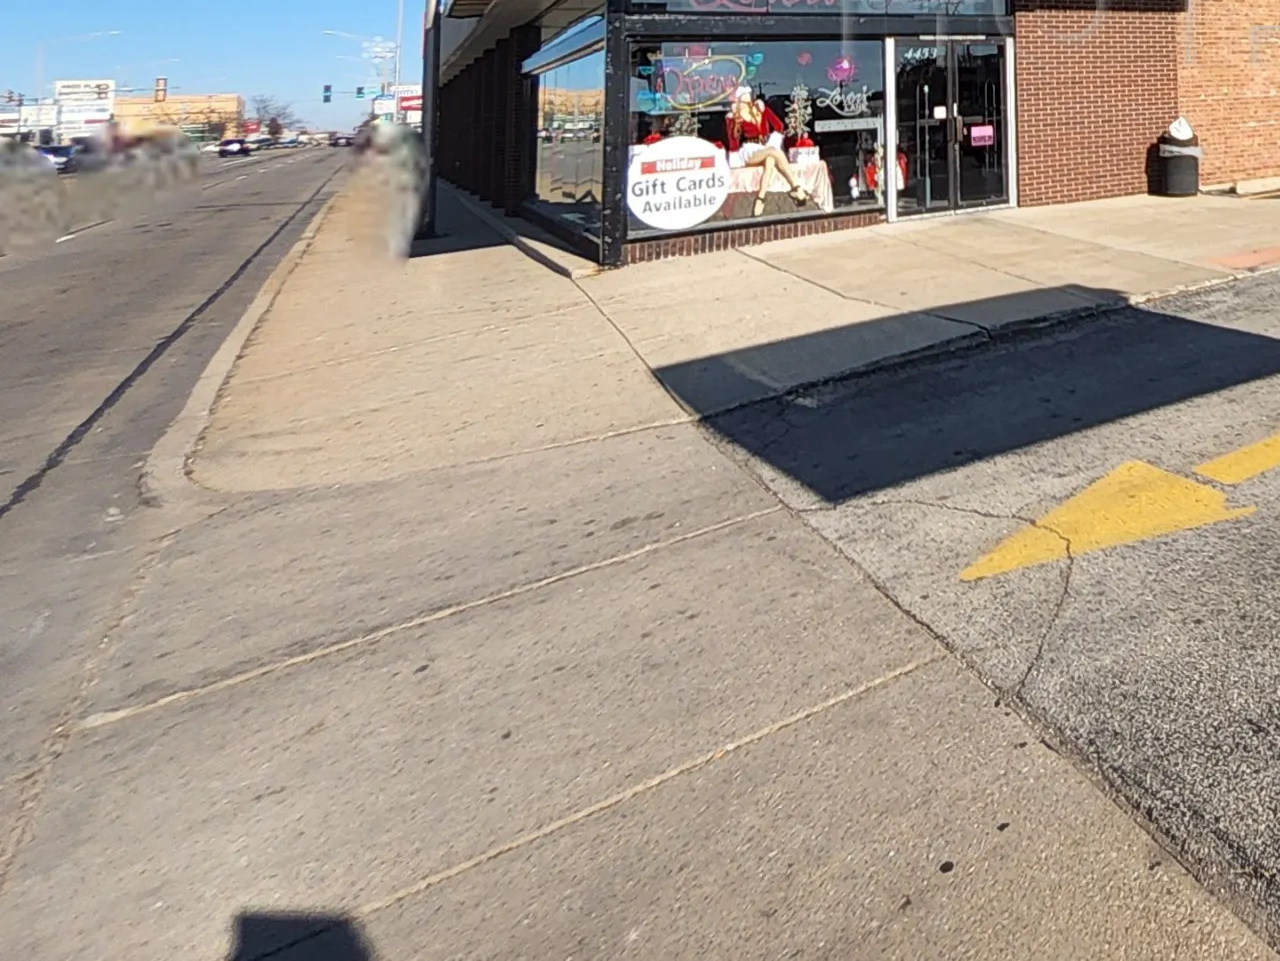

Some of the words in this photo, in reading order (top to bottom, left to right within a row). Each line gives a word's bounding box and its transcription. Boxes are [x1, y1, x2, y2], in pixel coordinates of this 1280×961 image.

[656, 157, 703, 173] Holiday
[631, 177, 667, 198] Gift
[676, 173, 725, 192] Cards
[642, 194, 717, 215] Available
